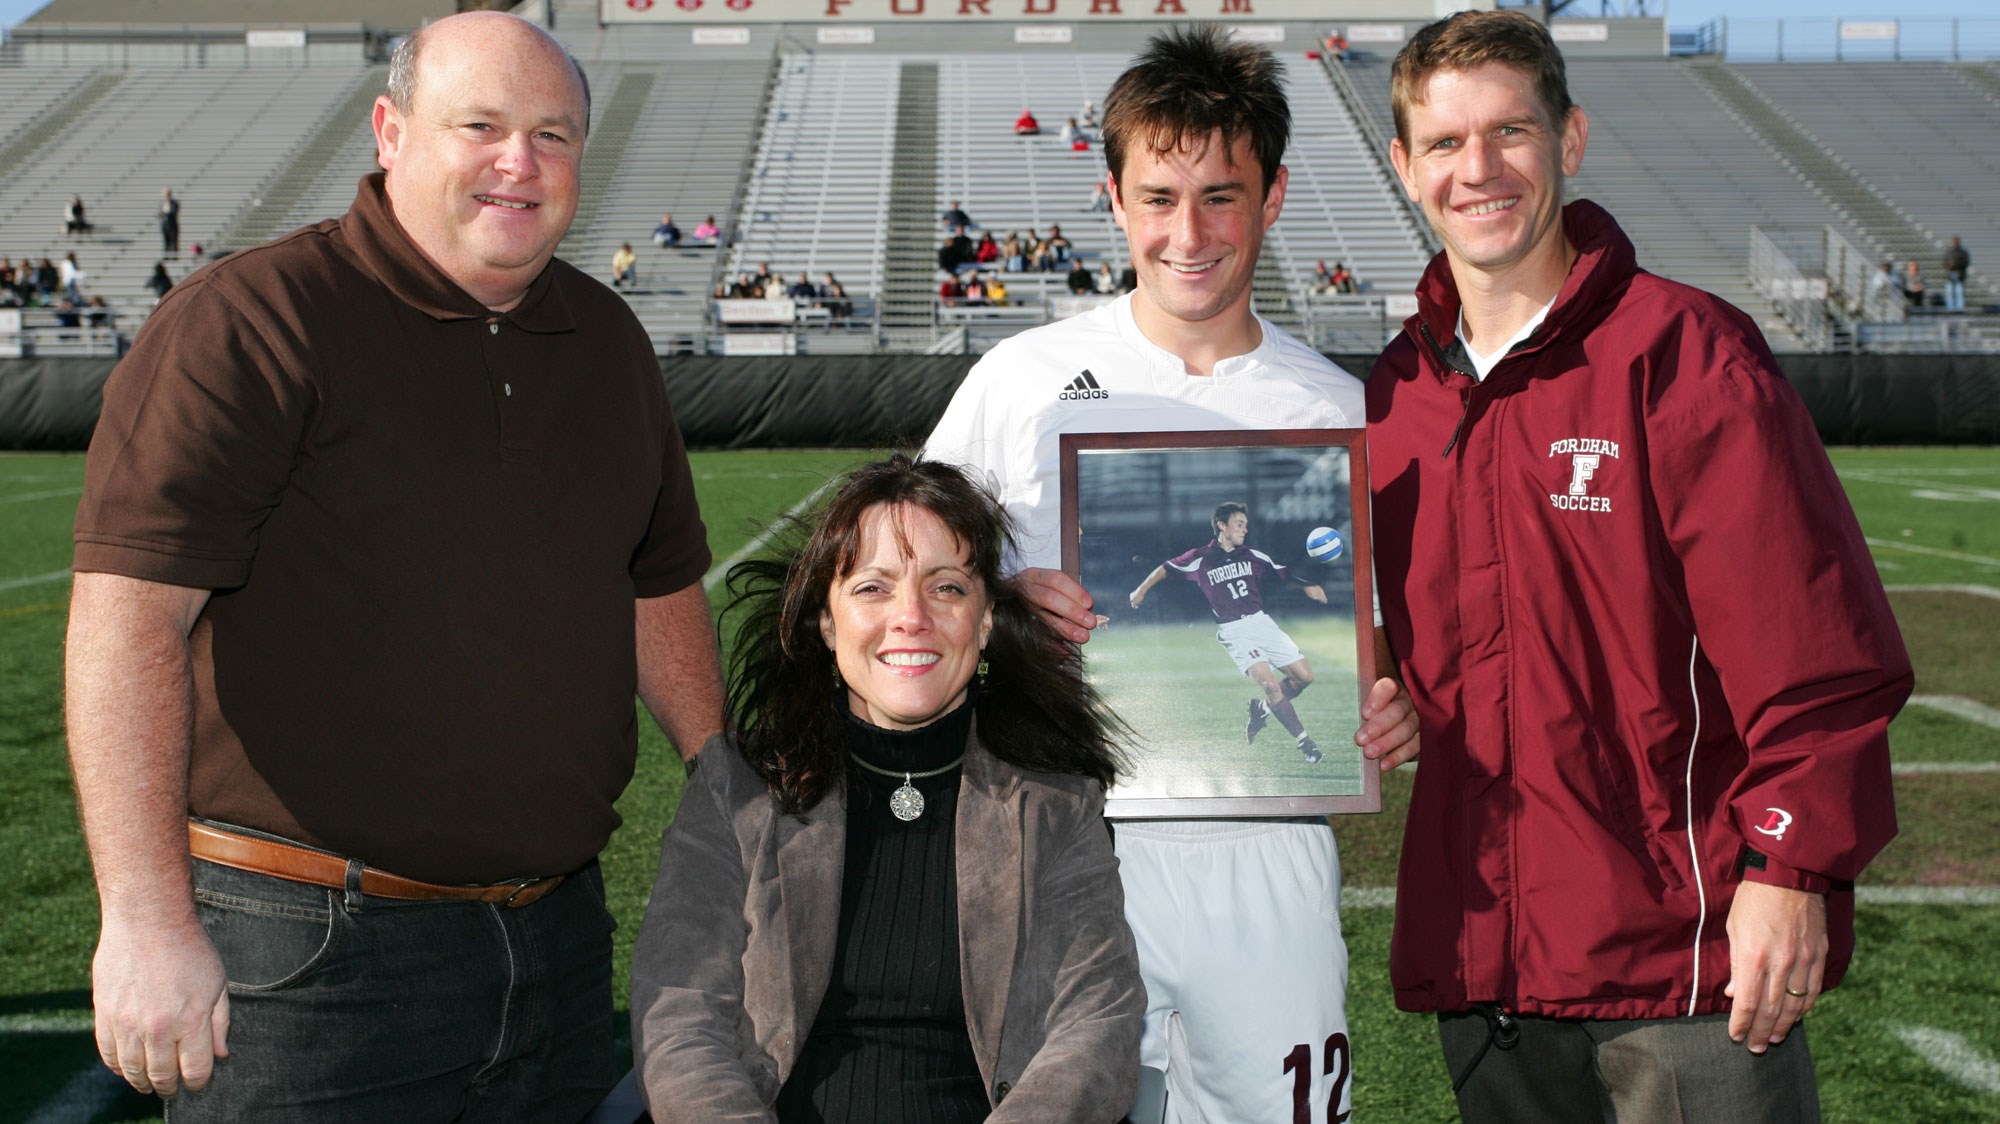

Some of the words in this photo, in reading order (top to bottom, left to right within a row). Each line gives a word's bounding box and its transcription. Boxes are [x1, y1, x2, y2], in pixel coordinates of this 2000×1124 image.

[1059, 389, 1109, 401] adidas
[1549, 438, 1619, 459] FORDHAM
[1569, 454, 1599, 495] F
[1550, 494, 1612, 512] SOCCER
[1207, 561, 1253, 587] FORDHAM
[1227, 580, 1249, 600] 12
[1283, 1032, 1351, 1124] 12
